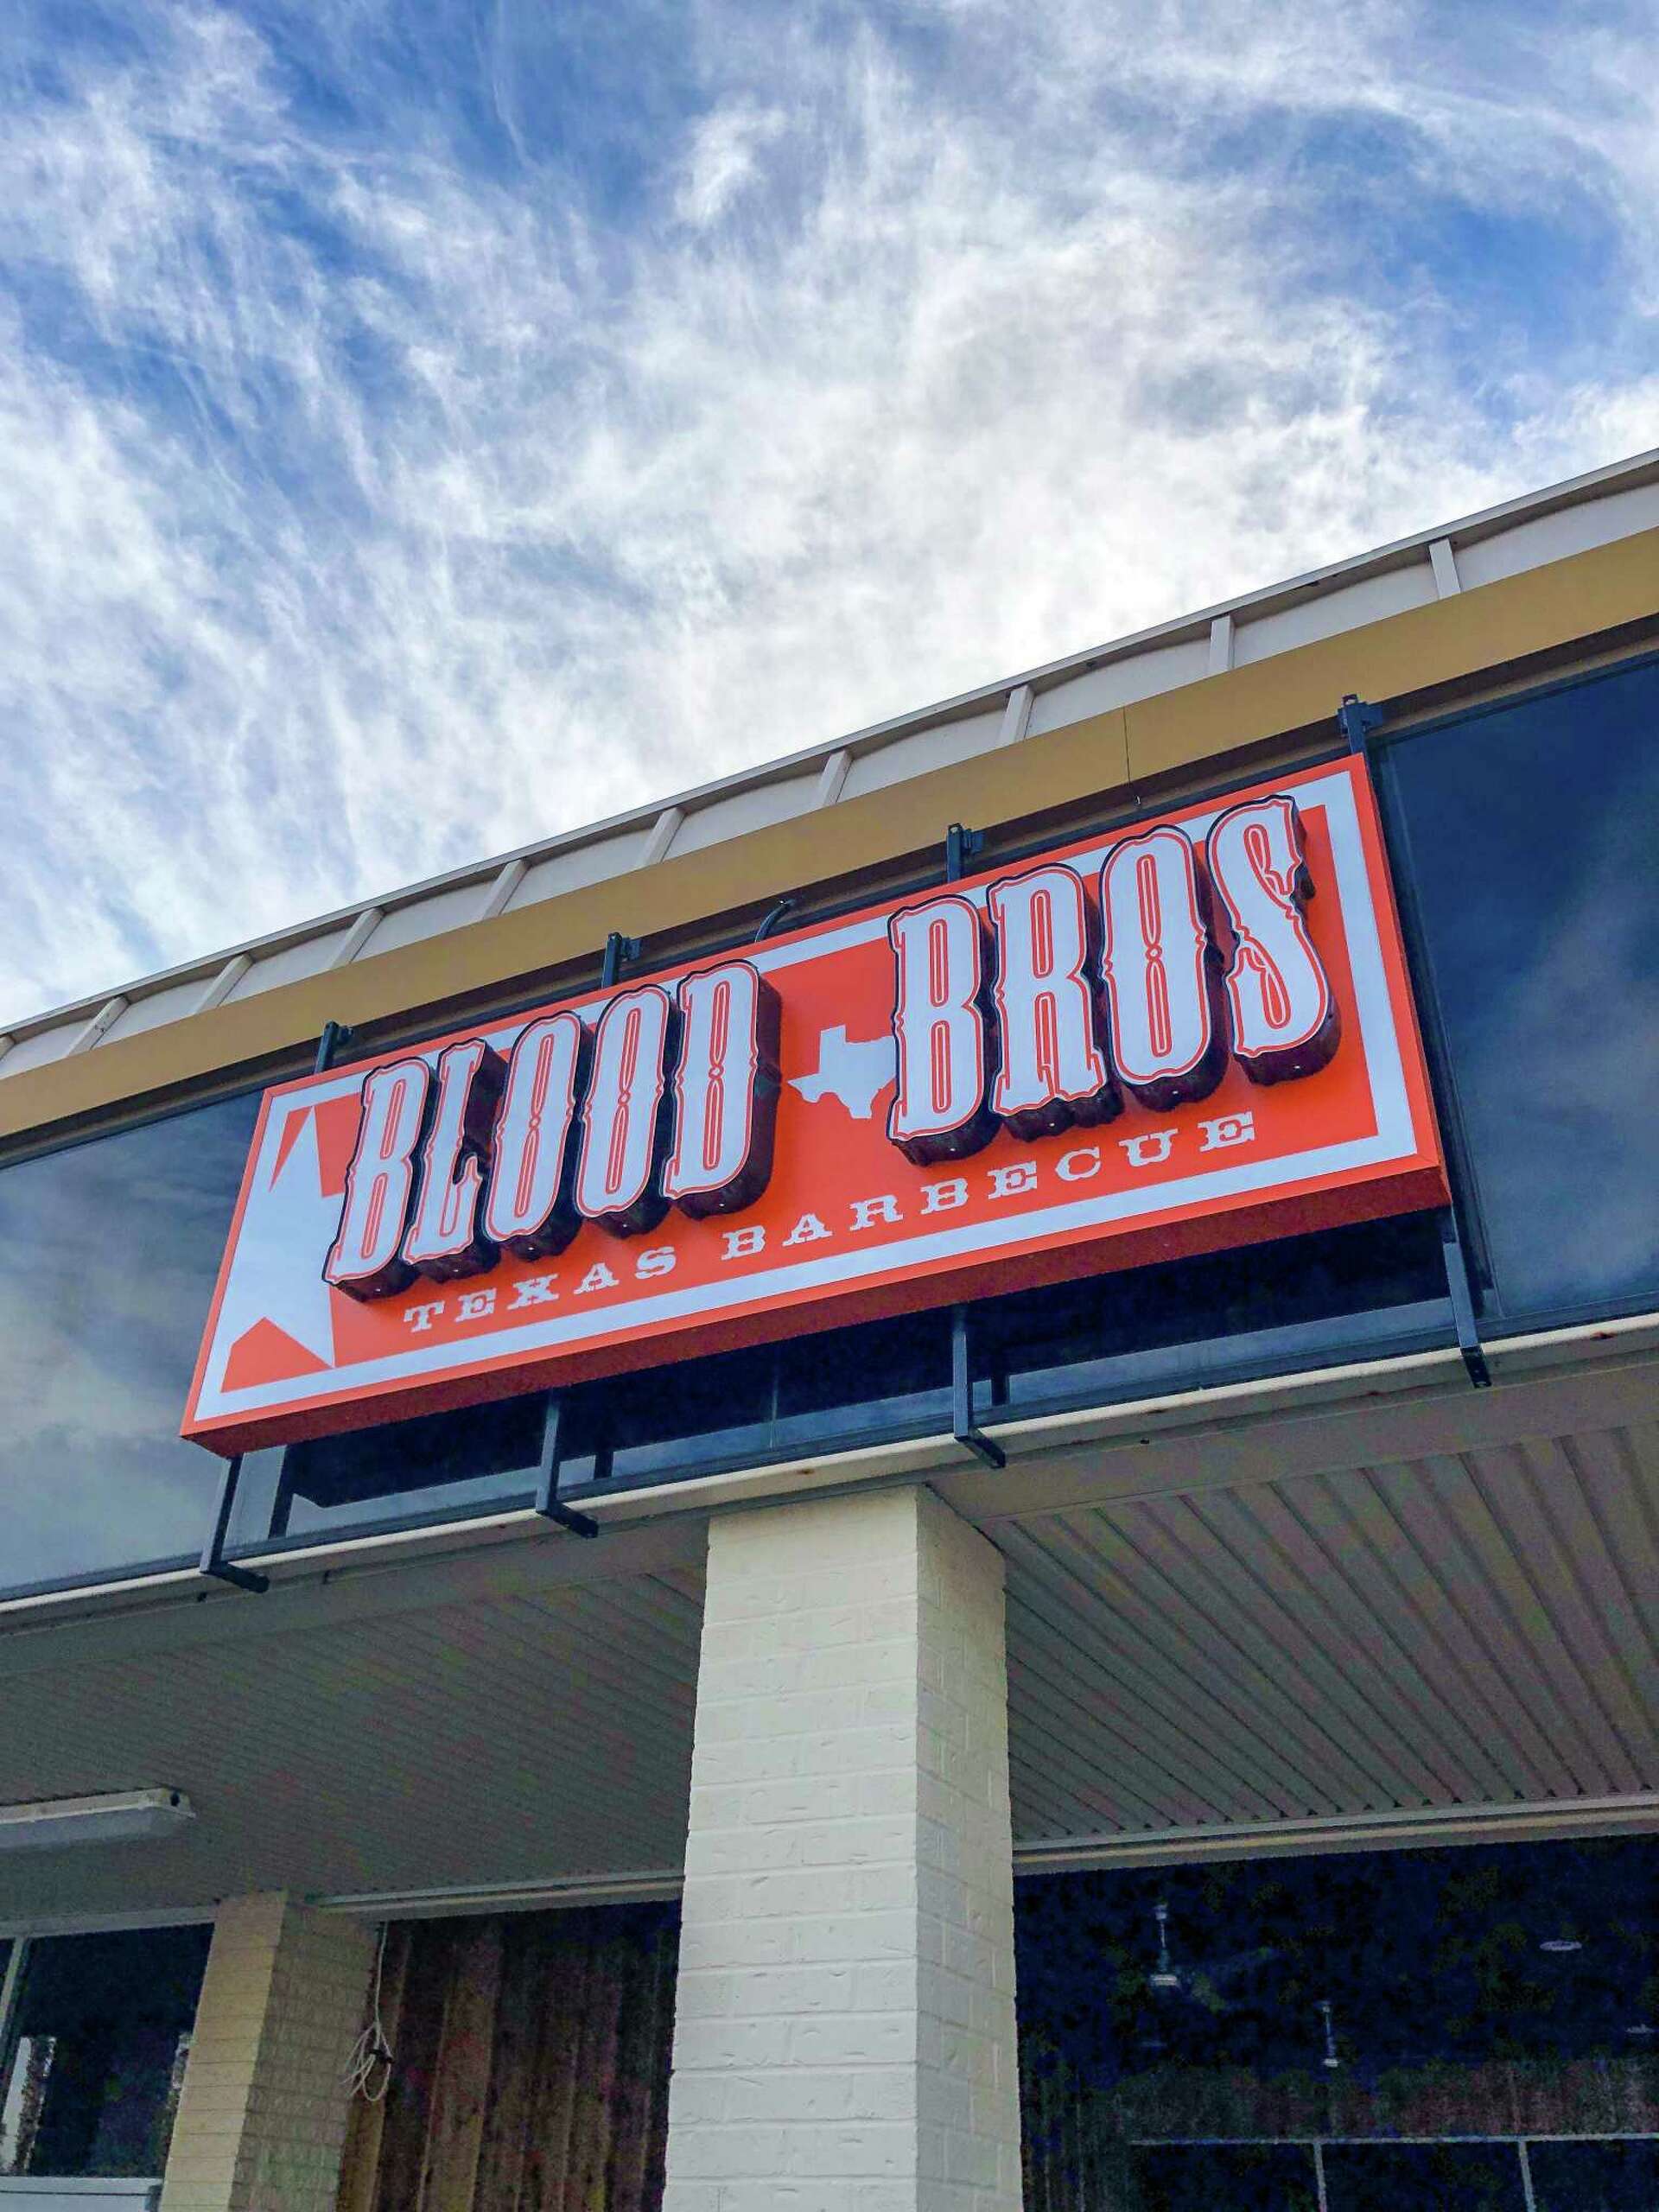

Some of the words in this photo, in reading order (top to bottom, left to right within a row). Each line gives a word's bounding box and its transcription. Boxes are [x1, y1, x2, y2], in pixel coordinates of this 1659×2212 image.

[321, 959, 762, 1285] BLOOD
[887, 793, 1332, 1141] BROS
[404, 1245, 677, 1333] TEXAS
[721, 1110, 1256, 1261] BARBECUE
